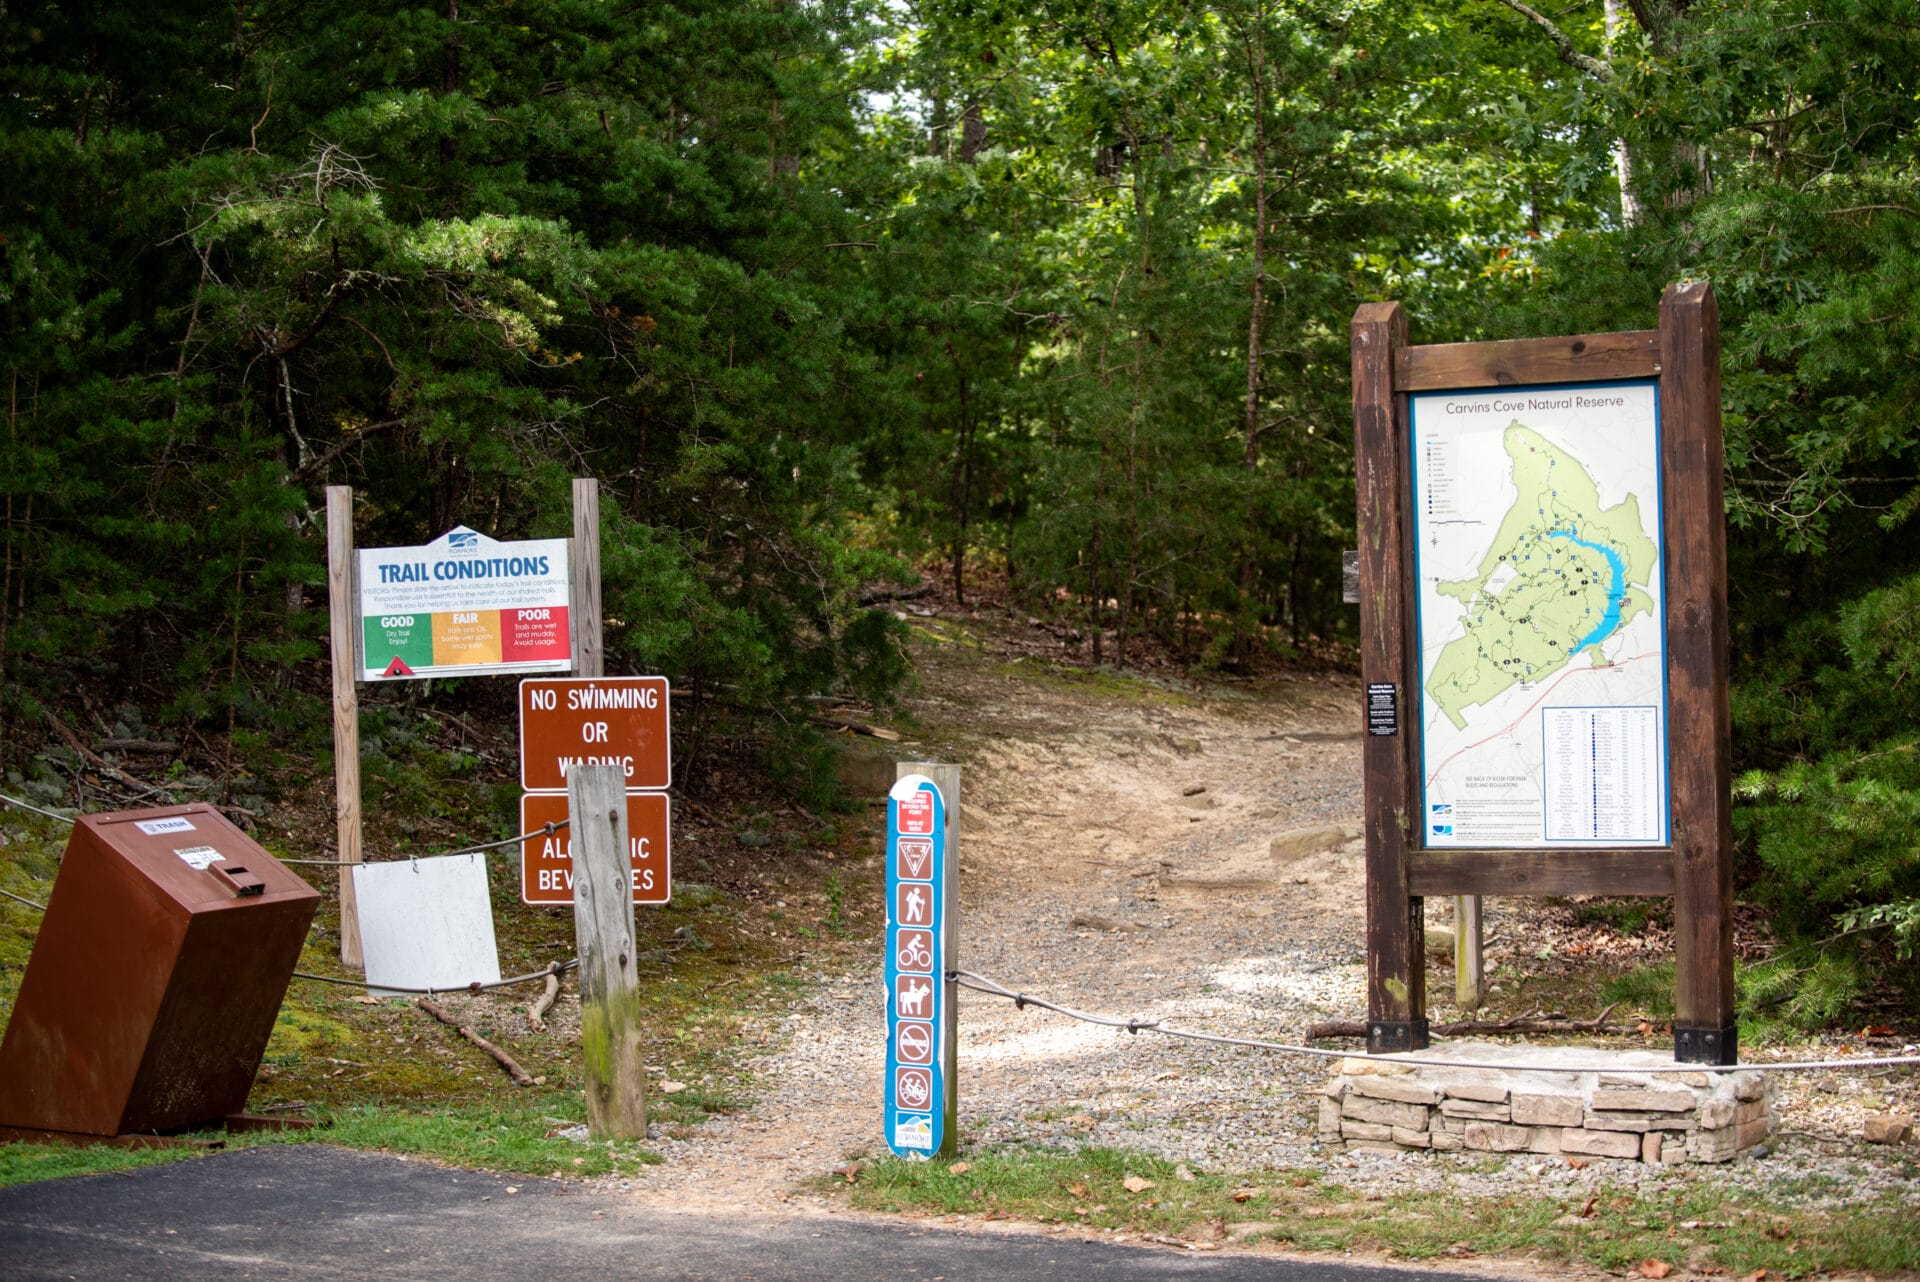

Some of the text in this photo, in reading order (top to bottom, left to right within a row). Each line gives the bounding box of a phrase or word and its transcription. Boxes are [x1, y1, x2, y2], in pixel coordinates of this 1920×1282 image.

[1446, 396, 1624, 414] Carvins Cove Natural Reserve
[378, 555, 550, 583] TRAIL CONDITIONS
[453, 612, 478, 624] FAIR
[518, 608, 551, 621] POOR
[381, 616, 415, 628] GOOD
[543, 621, 557, 629] wet
[386, 630, 397, 638] Dry
[530, 630, 556, 638] muddy.
[531, 688, 658, 710] NO SWIMMING
[582, 722, 608, 743] OR
[156, 820, 188, 830] TRASH
[539, 868, 654, 890] BEVES
